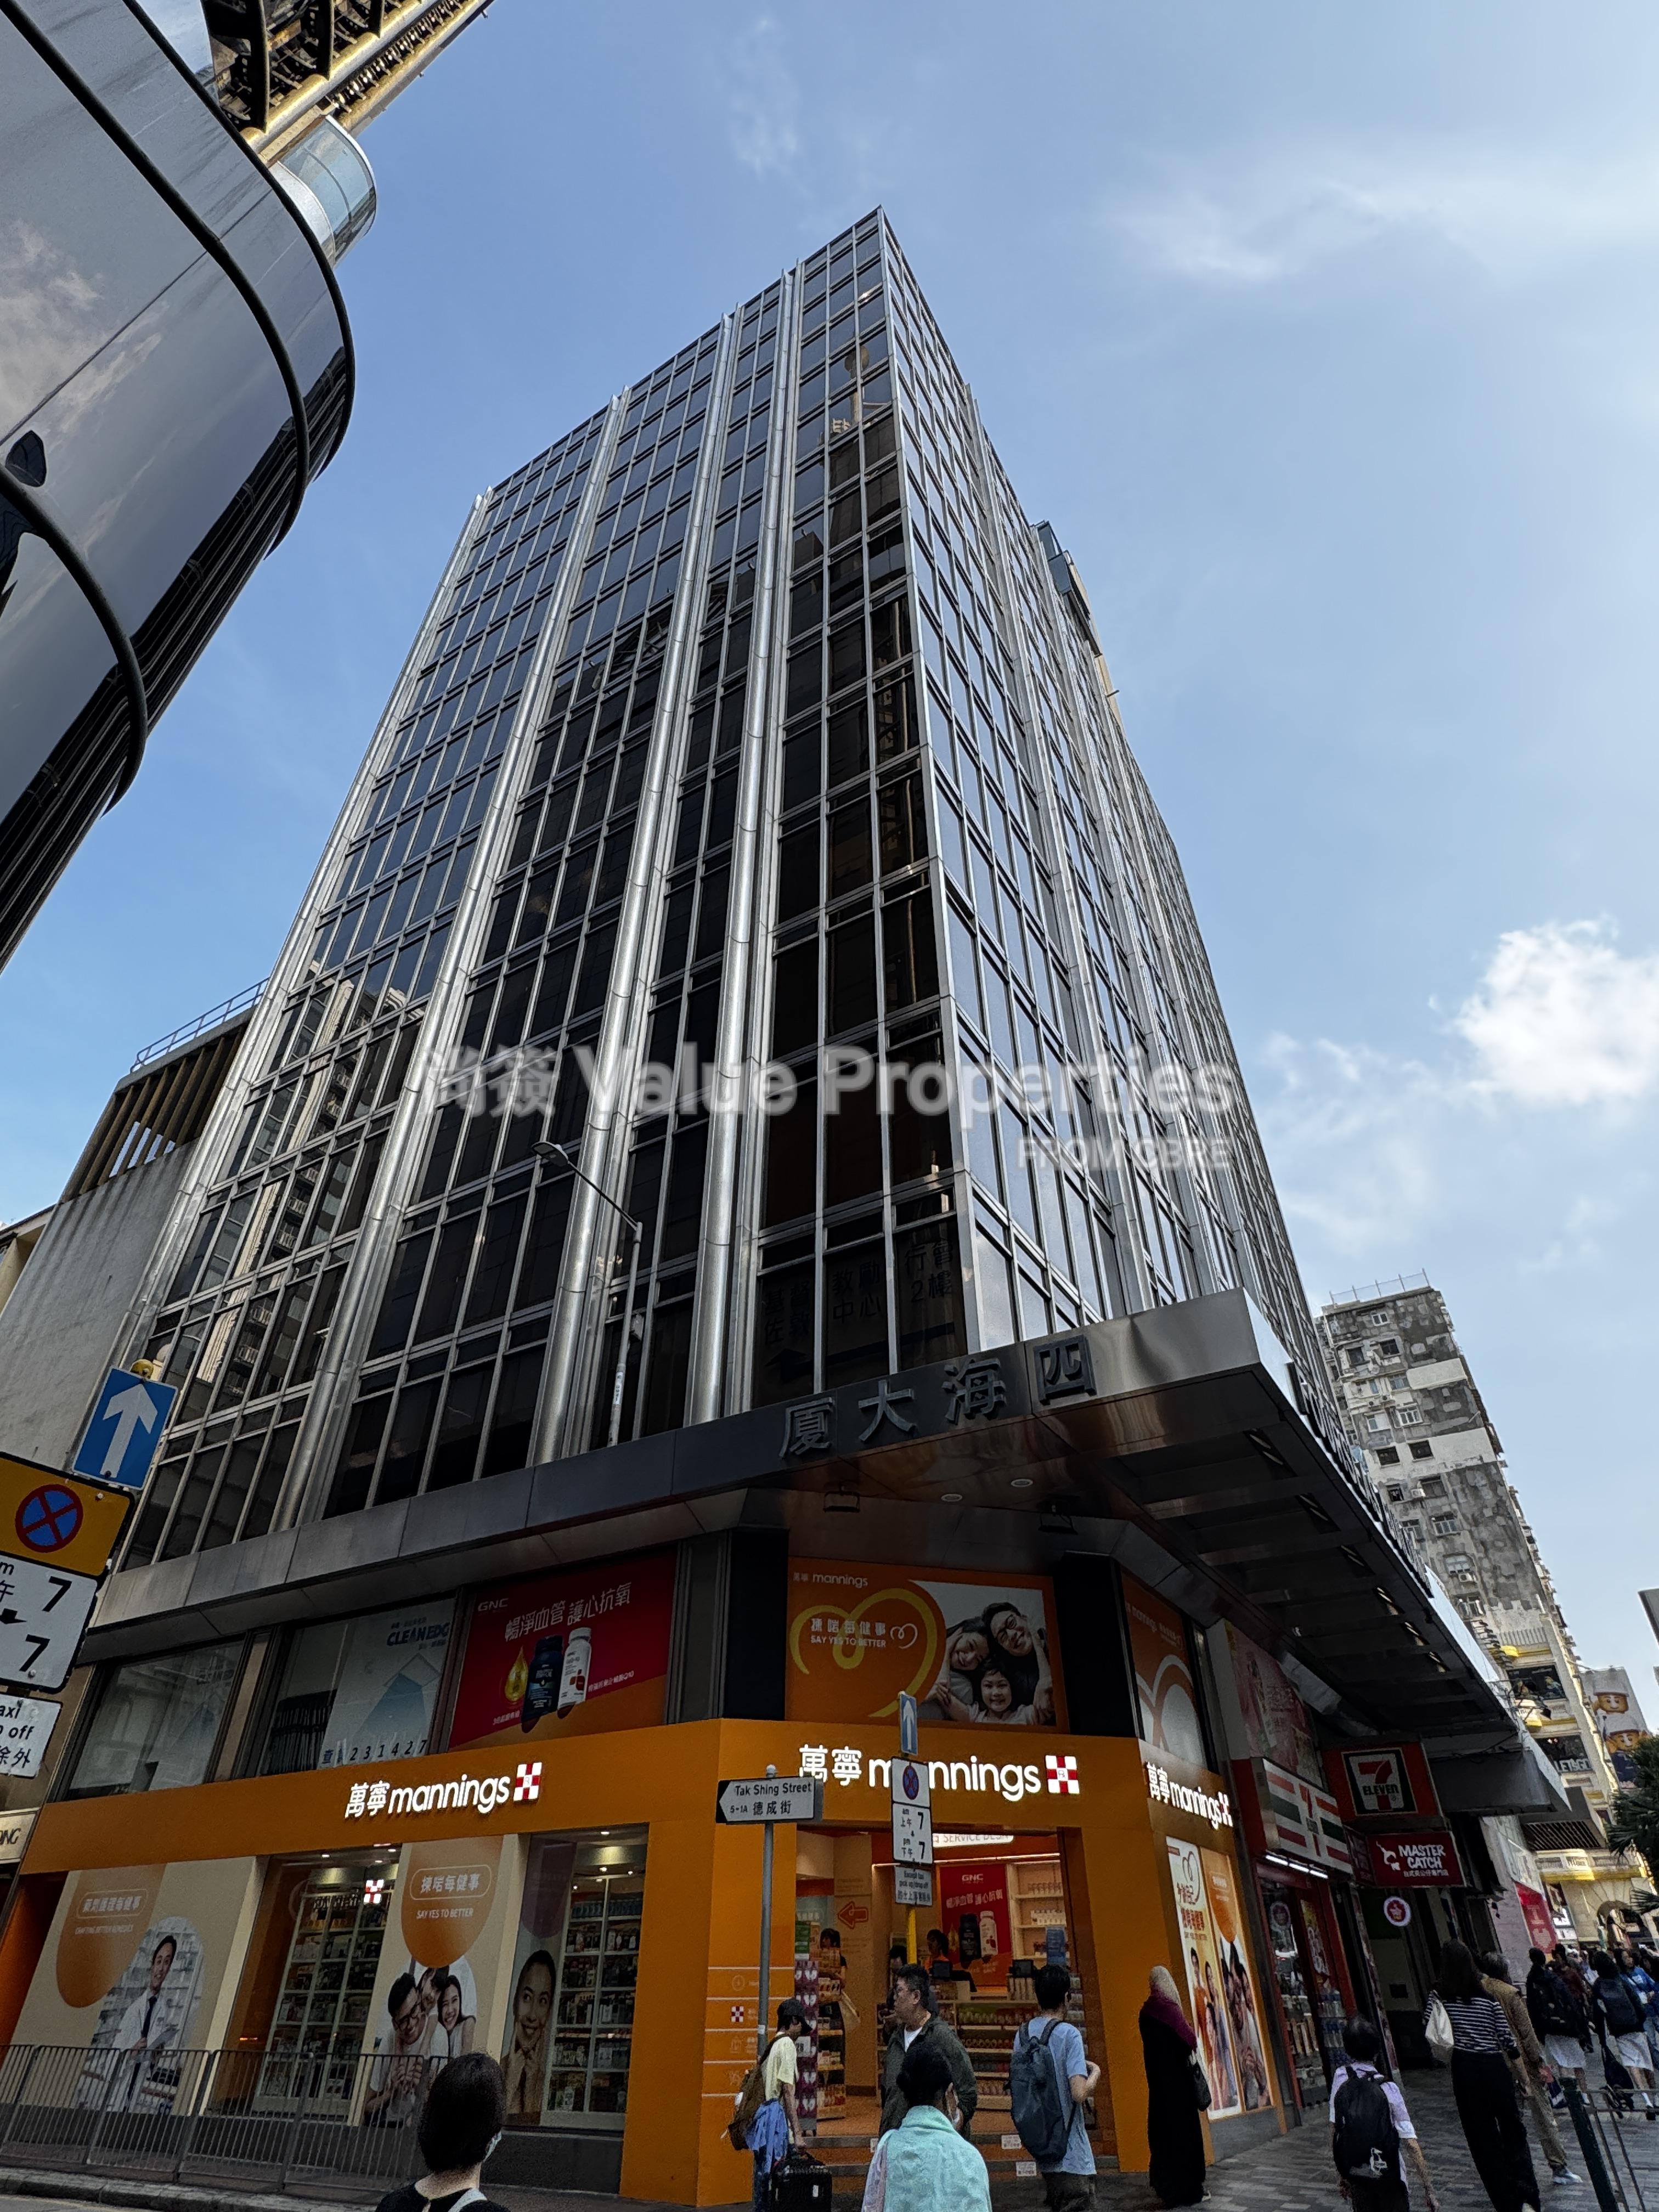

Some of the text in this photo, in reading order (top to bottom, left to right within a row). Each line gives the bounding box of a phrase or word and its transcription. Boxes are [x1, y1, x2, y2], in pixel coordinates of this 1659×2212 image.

[812, 1573, 868, 1588] mannings
[43, 1576, 72, 1612] 7
[477, 1598, 509, 1612] GNC
[811, 1635, 886, 1647] SAY YES TO BETTER
[19, 1634, 50, 1672] 7
[9, 1725, 35, 1740] off
[799, 1744, 1041, 1802] 萬寧 mnnings
[345, 1774, 510, 1819] 萬寧 mannings
[735, 1782, 812, 1796] Tak Shing Street
[1147, 1762, 1222, 1830] 萬寧 mannings
[753, 1800, 792, 1816] 德成街
[918, 1812, 924, 1830] 7
[918, 1841, 925, 1859] 7
[1398, 1844, 1446, 1858] MASTER
[1407, 1857, 1443, 1869] CATCH
[416, 1908, 474, 1919] SAY YES TO BETTER
